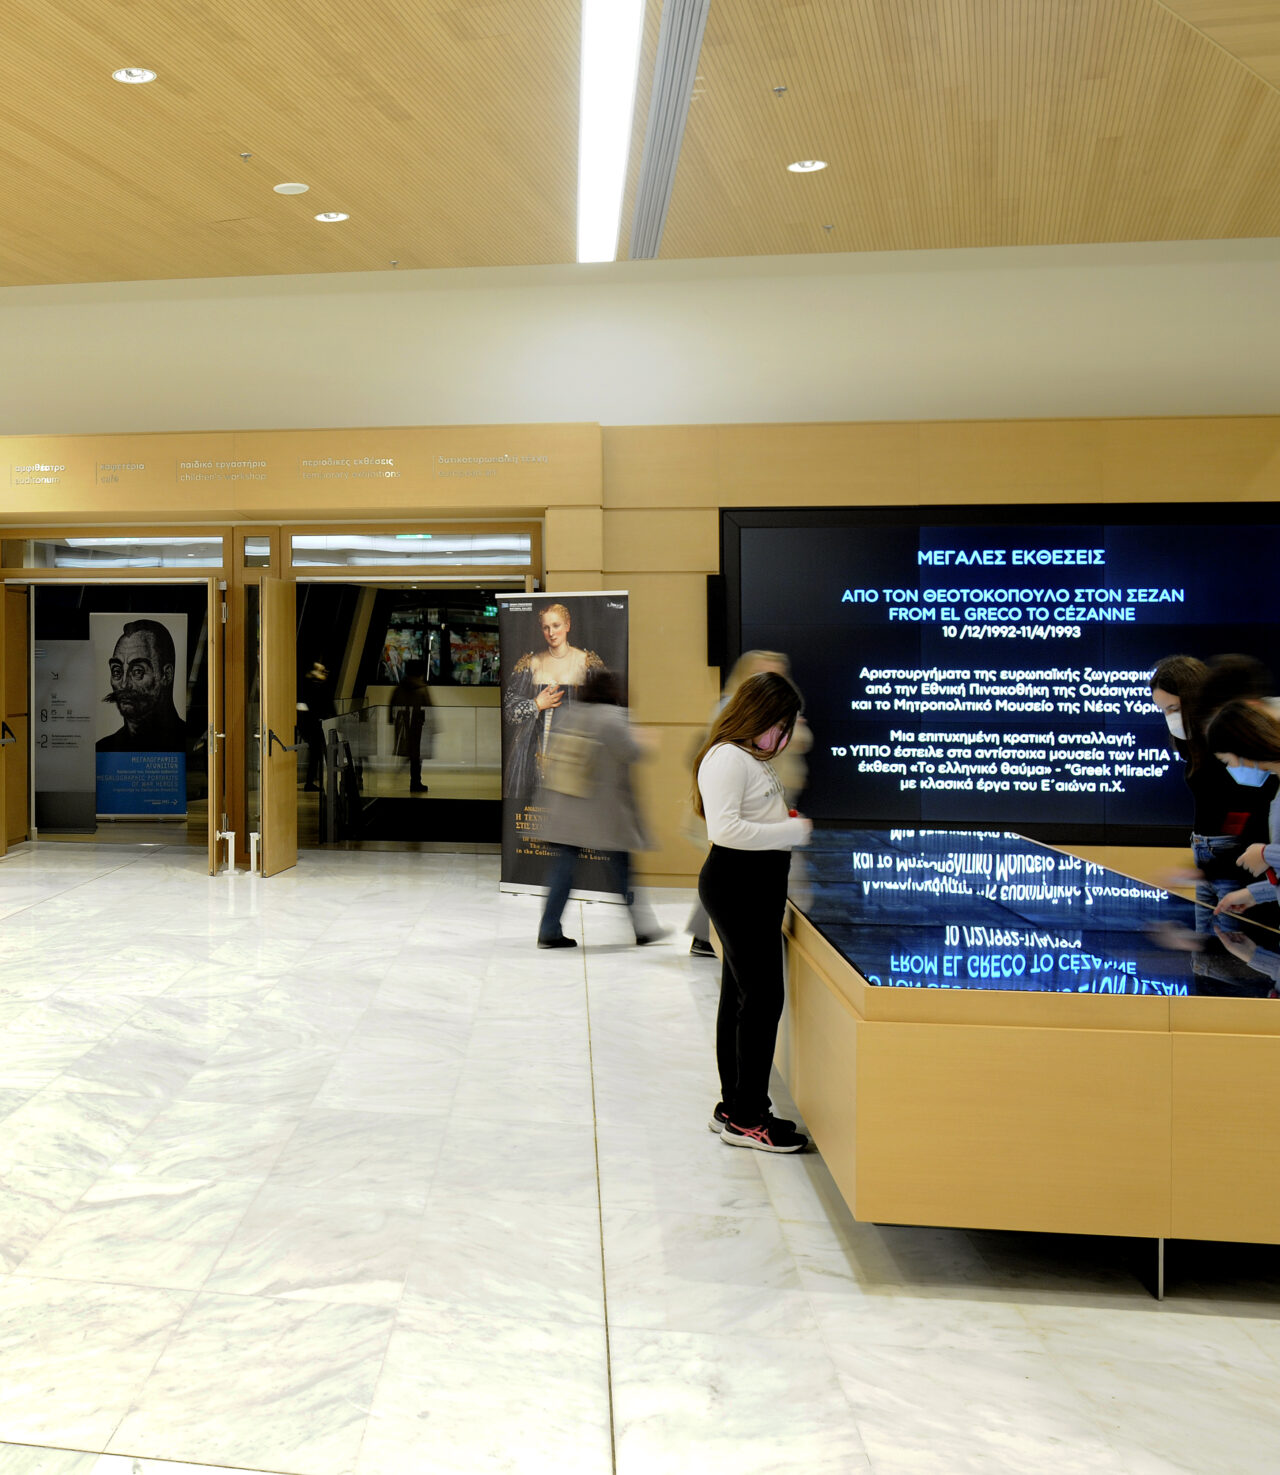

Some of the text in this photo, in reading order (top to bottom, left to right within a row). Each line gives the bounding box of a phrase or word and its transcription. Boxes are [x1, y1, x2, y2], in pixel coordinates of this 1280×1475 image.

[917, 549, 1106, 566] ΜΕΓΑΛΕΣ ΕΚΘΕΣΕΙΣ
[841, 588, 1185, 603] ΑΠΟ ΤΟΝ ΘΕΟΤΟΚΟΠΟΥΛΟ ΣΤΟΝ ΣΕΖΑΝ
[888, 604, 1136, 622] FROM EL GRECO TO CÉZANNE
[942, 624, 1082, 640] 10 /12/1992-11/4/1993
[859, 667, 1157, 683] Αριστουργήματα της ευρωπαϊκής ζωγραφικ
[865, 682, 1152, 699] από την Εθνική Πινακοθήκη της Ουάσιγκτο
[851, 698, 1162, 714] και το Μητροπολιτικό Μουσείο της Νέας Υόρκ
[890, 729, 1137, 746] Μια επιτυχημένη κρατική ανταλλαγή:
[831, 746, 847, 757] το
[850, 745, 892, 757] ΥΠΠΟ
[894, 745, 944, 759] έστειλε
[947, 747, 972, 759] στα
[974, 746, 1046, 761] αντίστοιχα
[1049, 748, 1104, 762] μουσεία
[1108, 751, 1134, 761] των
[1138, 748, 1170, 761] ΗΠΑ
[858, 760, 907, 775] έκθεση
[910, 761, 936, 774] «Το
[938, 761, 998, 776] ελληνικό
[1000, 762, 1052, 777] θαύμα»
[900, 779, 917, 791] με
[920, 777, 974, 791] κλασικά
[976, 778, 1010, 793] έργα
[1013, 780, 1038, 791] του
[1099, 780, 1126, 793] π.Χ.
